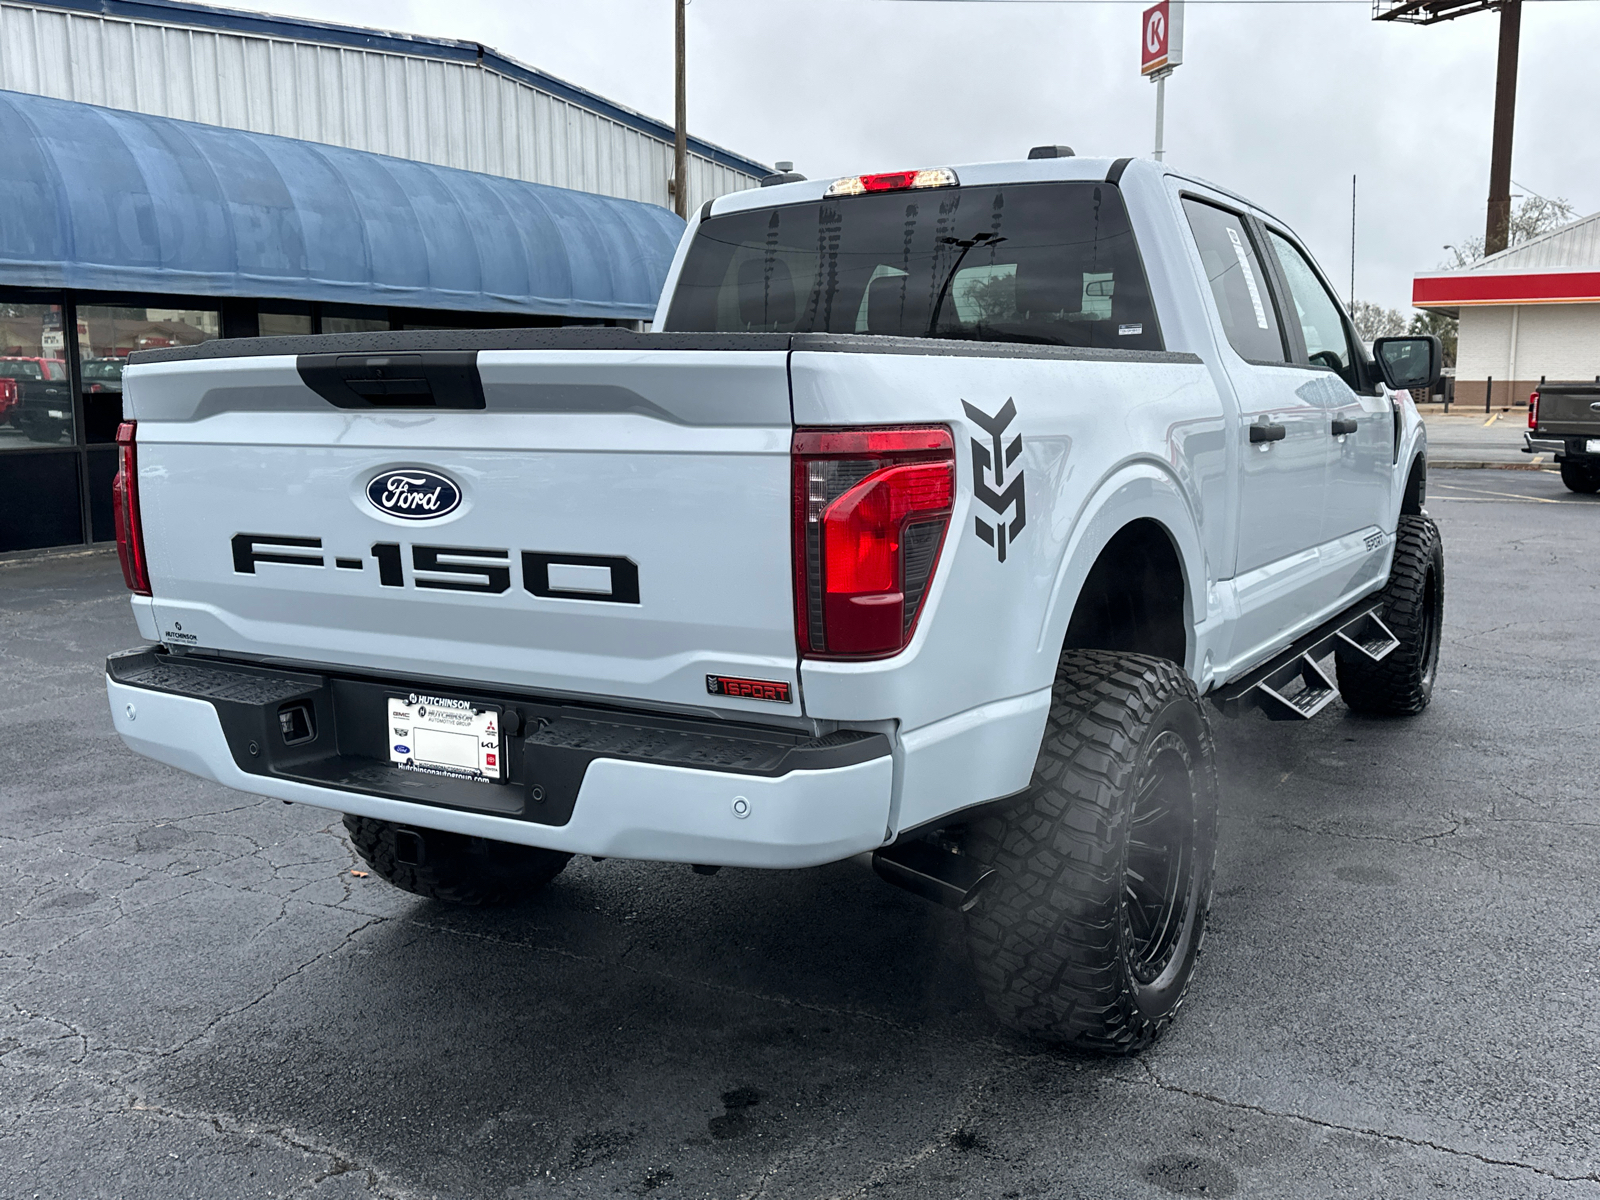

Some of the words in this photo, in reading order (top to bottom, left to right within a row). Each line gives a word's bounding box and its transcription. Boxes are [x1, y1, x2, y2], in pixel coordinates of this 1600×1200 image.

[381, 475, 442, 511] Ford
[231, 532, 642, 607] F-150
[165, 631, 197, 640] HUTCHINSON
[418, 695, 470, 709] HUTCHINSON
[428, 709, 473, 722] HUTCHINSON
[428, 717, 455, 725] AUTOMOTIVE
[398, 762, 490, 784] Hutchinsonautogroupcom
